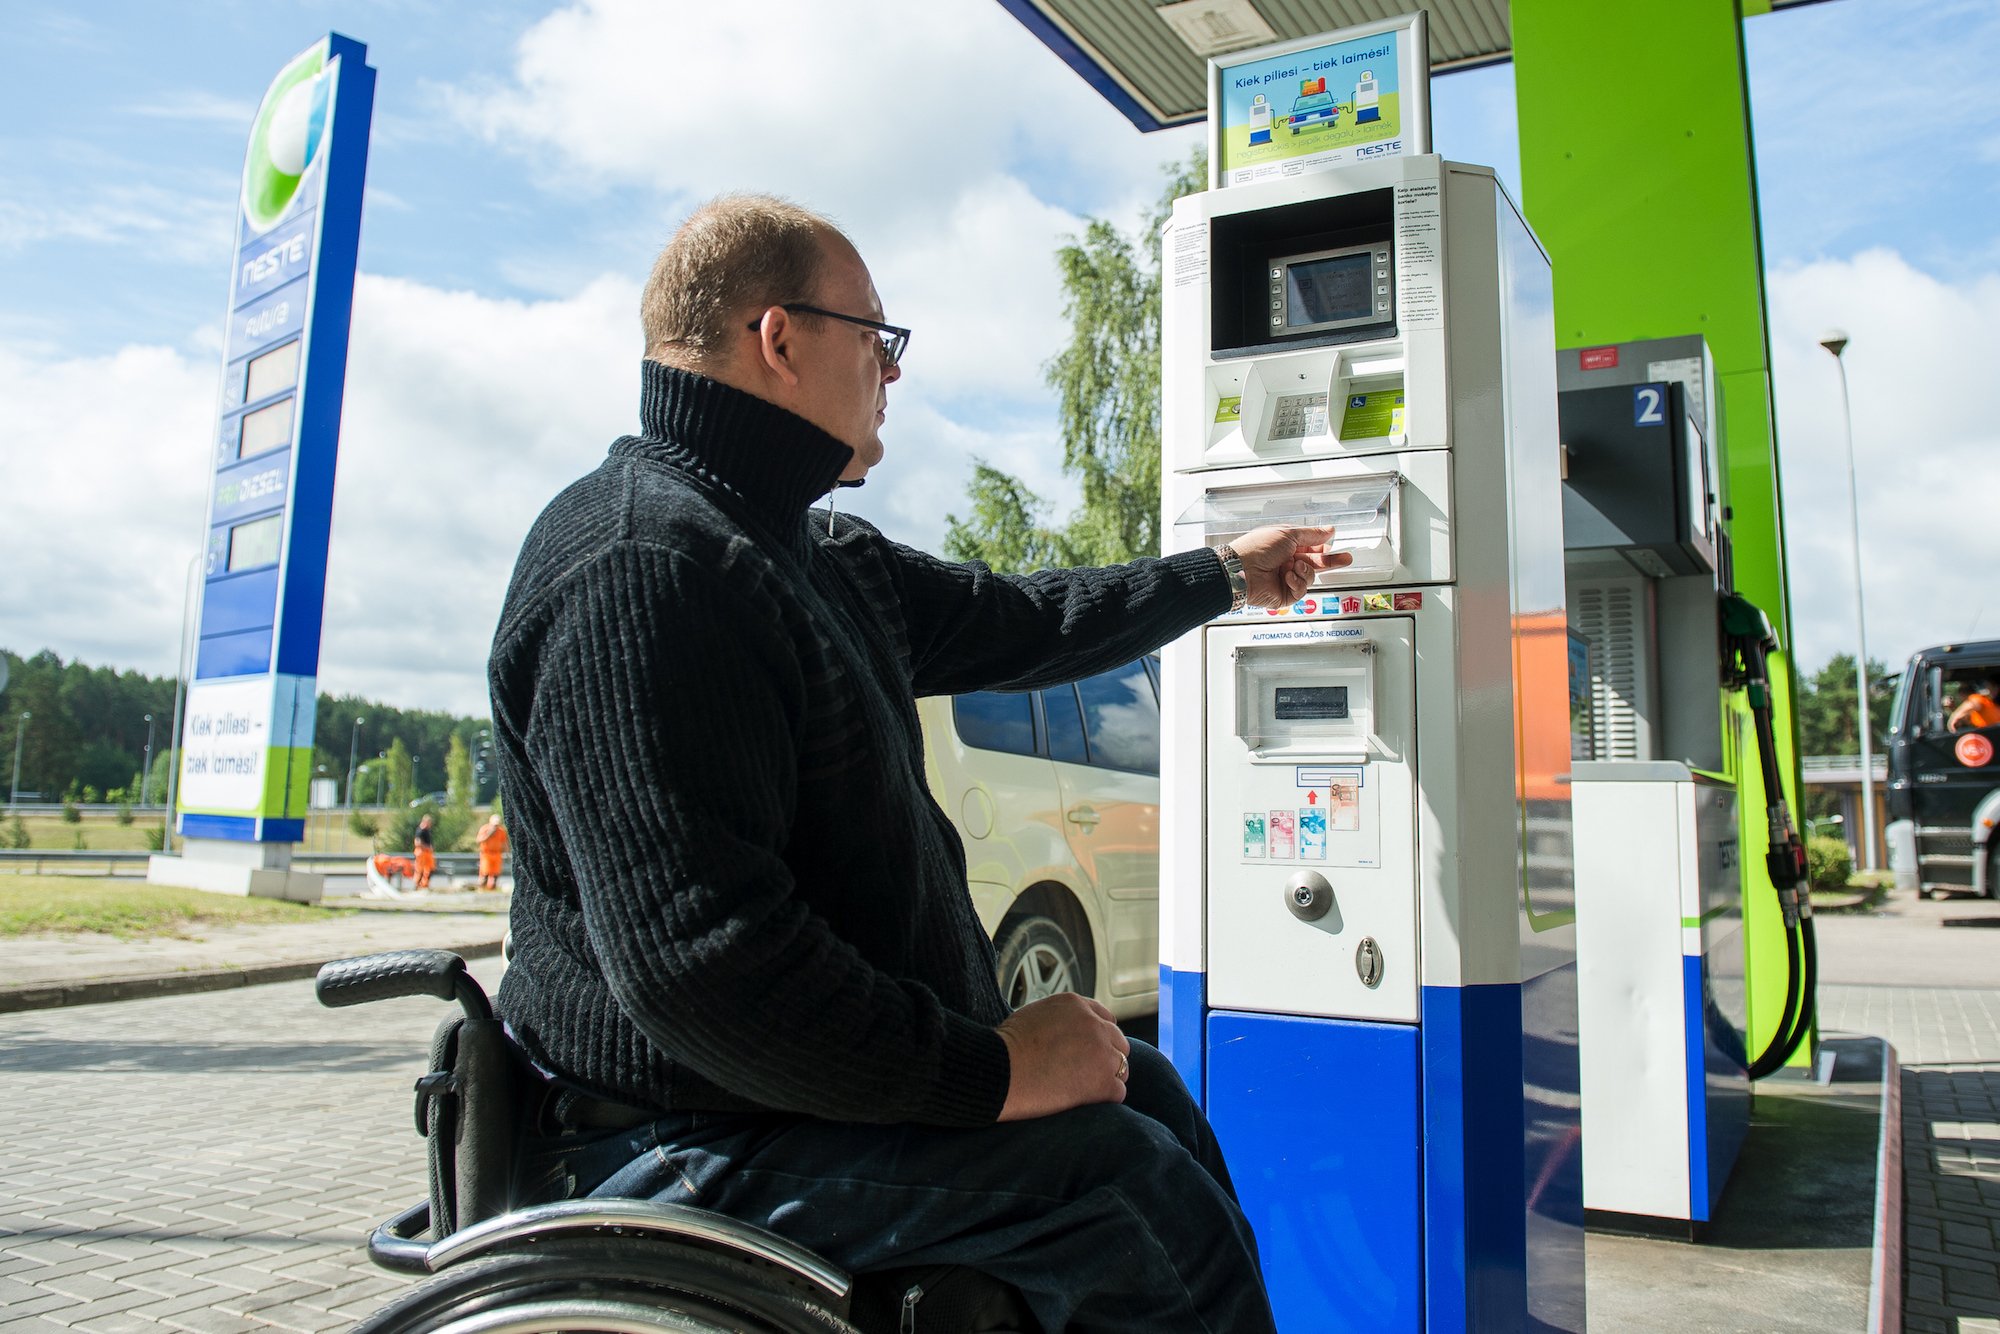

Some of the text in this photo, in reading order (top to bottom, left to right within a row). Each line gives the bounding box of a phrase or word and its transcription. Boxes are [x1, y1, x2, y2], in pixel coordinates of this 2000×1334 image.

[1235, 74, 1260, 89] Kiek
[1264, 66, 1299, 85] piliesi
[1313, 56, 1339, 71] tiek
[1341, 45, 1391, 65] laimėsi!
[1356, 140, 1402, 157] NESTE
[241, 232, 306, 289] NESTE
[1636, 388, 1663, 423] 2
[1252, 632, 1292, 640] AUTOMATAS
[1294, 630, 1324, 640] GRĄŽOS
